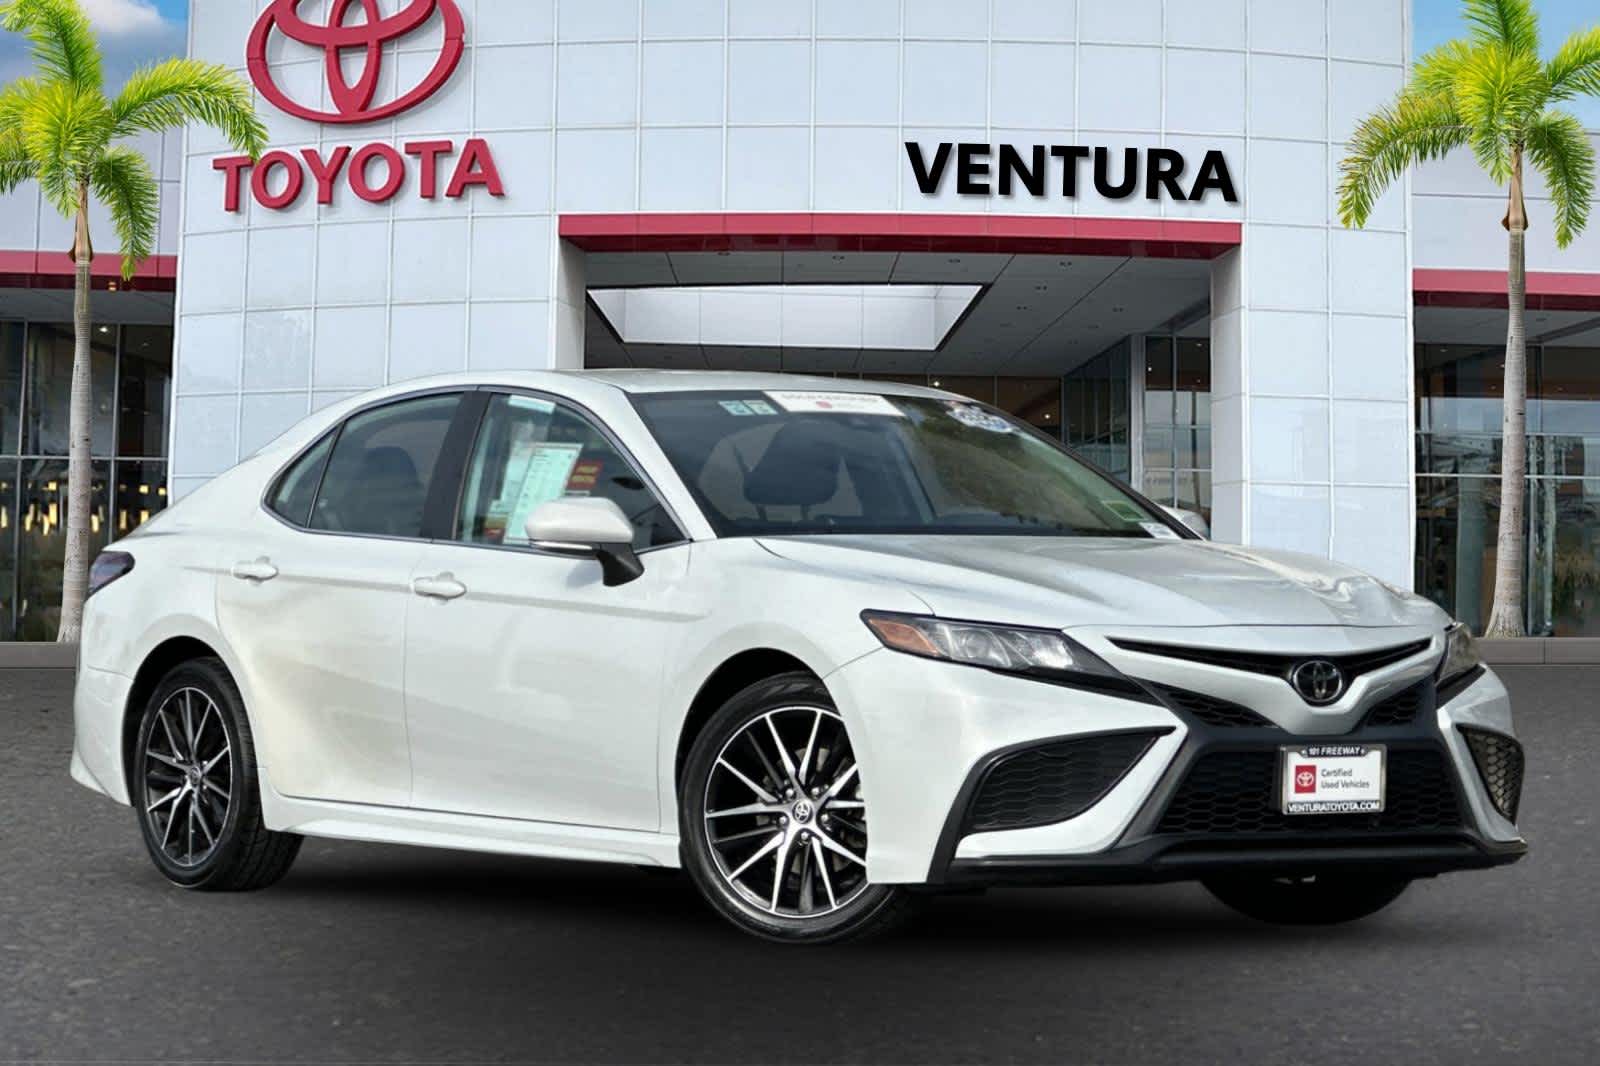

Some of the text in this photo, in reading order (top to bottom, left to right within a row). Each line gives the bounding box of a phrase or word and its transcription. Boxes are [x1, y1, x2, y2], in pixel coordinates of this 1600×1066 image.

[213, 138, 505, 212] TOYOTA
[905, 141, 1238, 203] VENTURA
[1309, 747, 1361, 756] 101 FREEWAY
[1321, 769, 1352, 777] Certified
[1341, 779, 1370, 788] Vehicles
[1288, 801, 1380, 812] VENTURATOYOTA.COM
